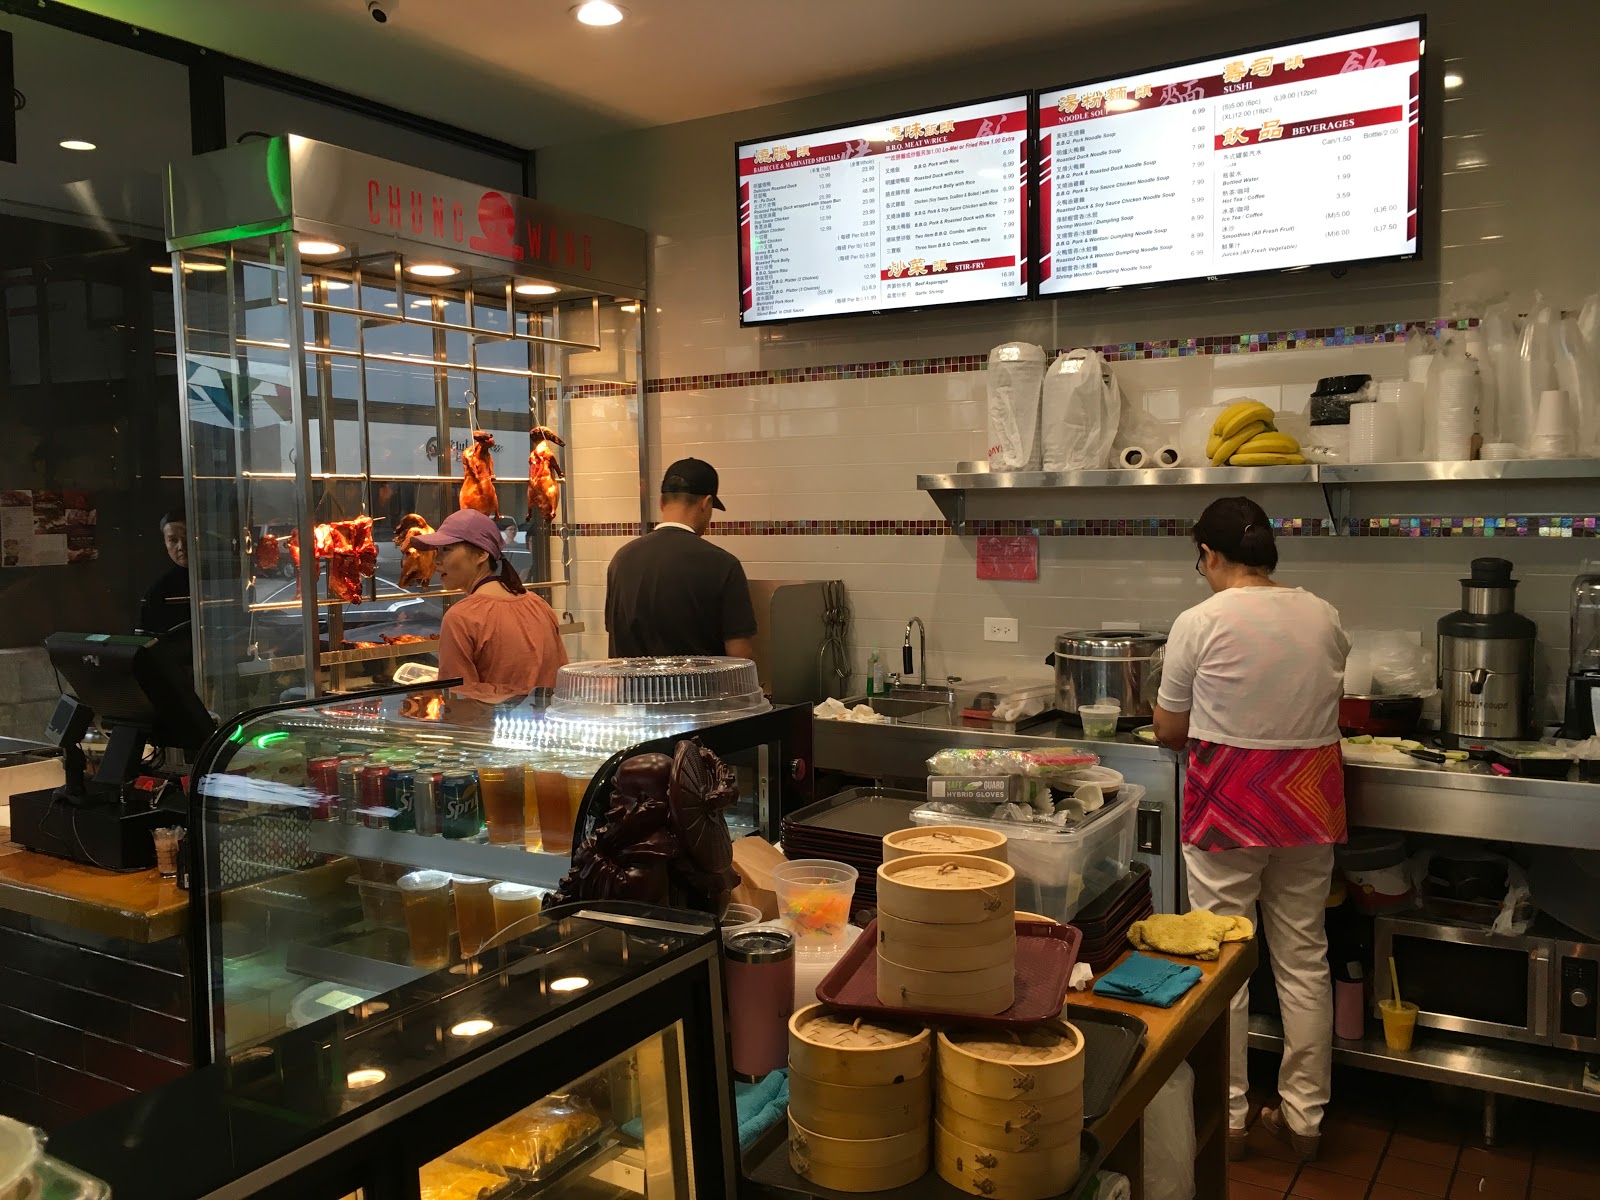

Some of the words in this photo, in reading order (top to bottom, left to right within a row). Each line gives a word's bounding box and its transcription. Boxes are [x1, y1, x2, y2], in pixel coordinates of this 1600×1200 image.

[1223, 81, 1252, 93] SUSHI
[1273, 92, 1295, 102] (L)9.00
[1297, 88, 1317, 97] (12pc)
[1222, 101, 1244, 110] (S)5.00
[1058, 112, 1089, 123] NOODLE
[1090, 108, 1109, 117] SOUP
[1292, 118, 1354, 135] BEVERAGES
[1084, 133, 1101, 141] Noodle
[1222, 119, 1284, 147] 飲品
[1363, 128, 1398, 139] Bottle/2.00
[885, 143, 902, 152] B.B.Q.
[904, 140, 922, 149] MEAT
[924, 136, 947, 146] W/RICE
[965, 141, 977, 149] Fried
[978, 139, 989, 147] Rice
[990, 137, 1000, 145] 1.00
[1001, 135, 1014, 143] Extra
[1322, 135, 1351, 145] Can/1.50
[753, 164, 778, 173] BARBECUE
[785, 158, 815, 168] MARINATED
[816, 153, 840, 163] SPECIALS
[1089, 166, 1109, 174] Roasted
[1124, 161, 1141, 169] Noodle
[1191, 160, 1204, 168] 7.99
[1116, 180, 1136, 188] Chicken
[1156, 174, 1169, 182] Soup
[1055, 206, 1075, 214] Roasted
[1121, 196, 1141, 204] Chicken
[1142, 193, 1160, 201] Noodle
[1373, 204, 1397, 213] (L)6.00
[1325, 210, 1349, 219] (M)5.00
[368, 179, 464, 243] CHUNG
[527, 219, 592, 271] WANG
[1073, 220, 1092, 228] Wonton
[1096, 216, 1119, 225] Dumpling
[1373, 223, 1396, 232] (L)7.50
[1110, 232, 1133, 240] Dumpling
[1222, 231, 1250, 239] Smoothies
[1324, 229, 1349, 238] (M)6.00
[1115, 248, 1139, 256] Dumpling
[954, 262, 985, 270] STIR-FRY
[946, 780, 962, 789] SAFE
[984, 780, 1004, 790] GUARD
[446, 792, 478, 820] Sprit
